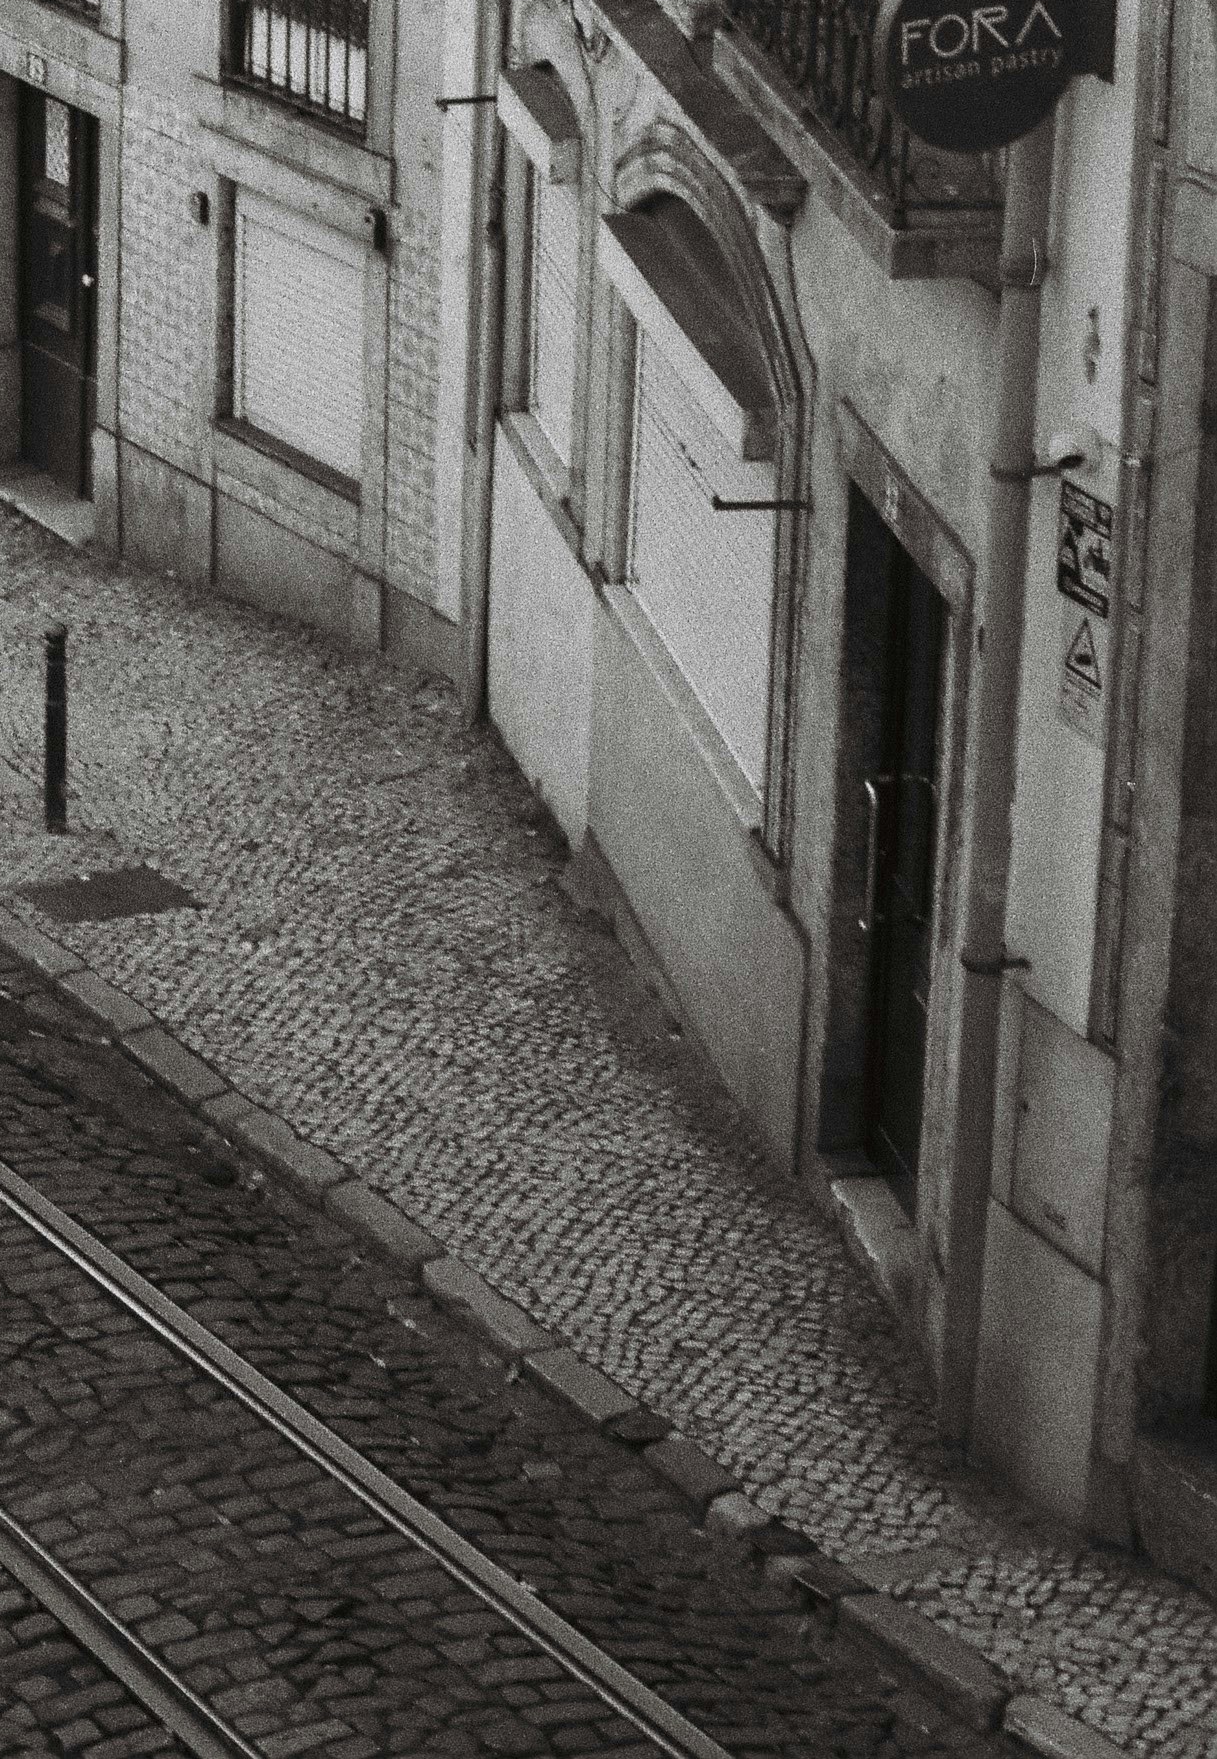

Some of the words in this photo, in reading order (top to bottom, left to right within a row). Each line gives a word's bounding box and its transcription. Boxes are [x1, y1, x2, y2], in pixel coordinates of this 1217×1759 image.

[901, 0, 1063, 65] FORA
[901, 60, 981, 90] artisan
[991, 48, 1062, 77] pastry
